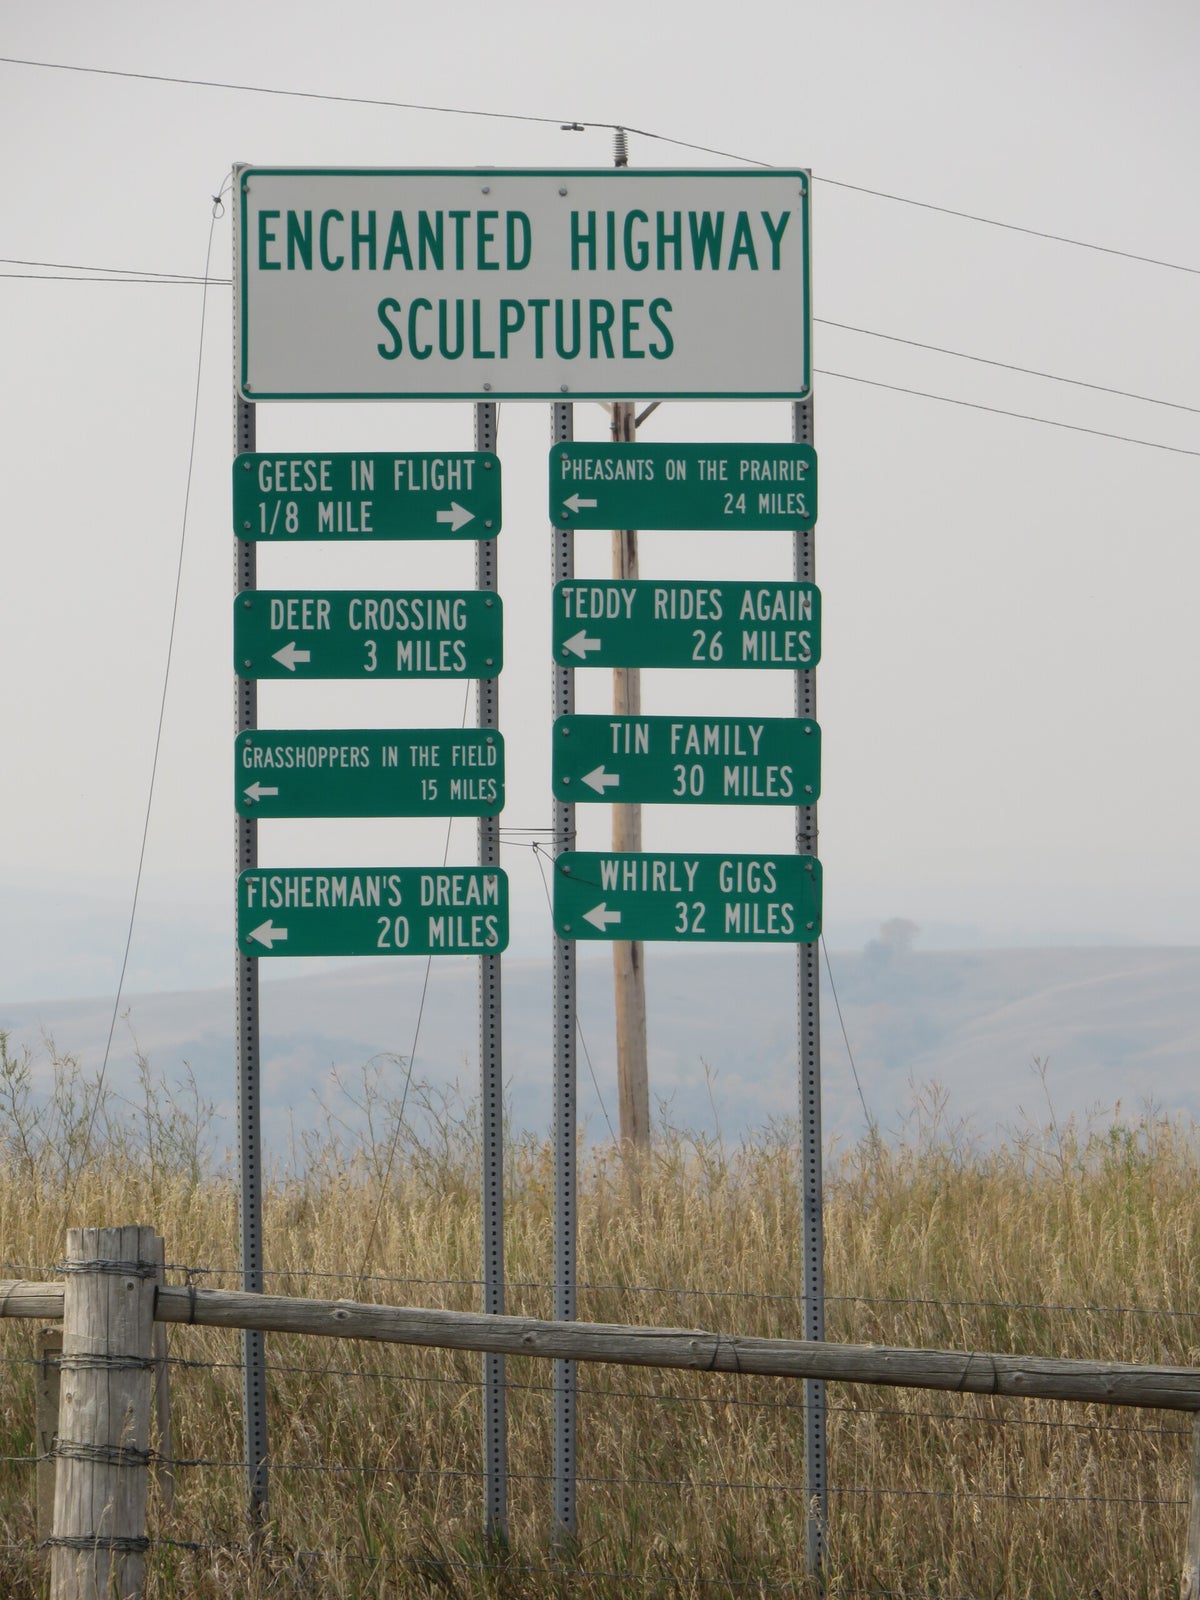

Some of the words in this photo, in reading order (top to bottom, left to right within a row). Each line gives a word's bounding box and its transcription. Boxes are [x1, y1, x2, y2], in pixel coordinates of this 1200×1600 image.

[258, 208, 532, 272] ENCHANTED
[570, 209, 791, 272] HIGHWAY
[377, 297, 675, 361] SCULPTURES
[258, 460, 332, 492] GEESE
[351, 460, 374, 491] IN
[394, 459, 475, 491] FLIGHT
[562, 459, 654, 481] PHEASANTS
[665, 459, 686, 481] ON
[699, 460, 728, 481] THE
[740, 460, 808, 481] PRAIRIE
[259, 500, 299, 535] 1/8
[318, 501, 373, 532] MILE
[724, 492, 746, 514] 24
[758, 493, 806, 515] MILES
[270, 599, 331, 630] DEER
[348, 598, 467, 631] CROSSING
[562, 587, 637, 619] TEDDY
[654, 588, 723, 621] RIDES
[739, 589, 812, 621] AGAIN
[364, 639, 377, 672] 3
[397, 639, 467, 672] MILES
[692, 629, 723, 661] 26
[742, 630, 811, 663] MILES
[610, 723, 649, 754] TIN
[671, 724, 764, 756] FAMILY
[242, 746, 370, 769] GRASSHOPPERS
[382, 746, 398, 767] IN
[411, 745, 440, 767] THE
[452, 745, 497, 766] FIELD
[421, 779, 438, 801] 15
[450, 778, 497, 802] MILES
[673, 764, 704, 796] 30
[724, 765, 793, 798] MILES
[245, 874, 402, 908] FISHERMAN'S
[420, 874, 498, 906] DREAM
[600, 860, 699, 892] WHIRLY
[719, 861, 777, 894] GIGS
[377, 916, 409, 948] 20
[429, 915, 499, 947] MILES
[675, 901, 706, 933] 32
[725, 902, 794, 935] MILES
